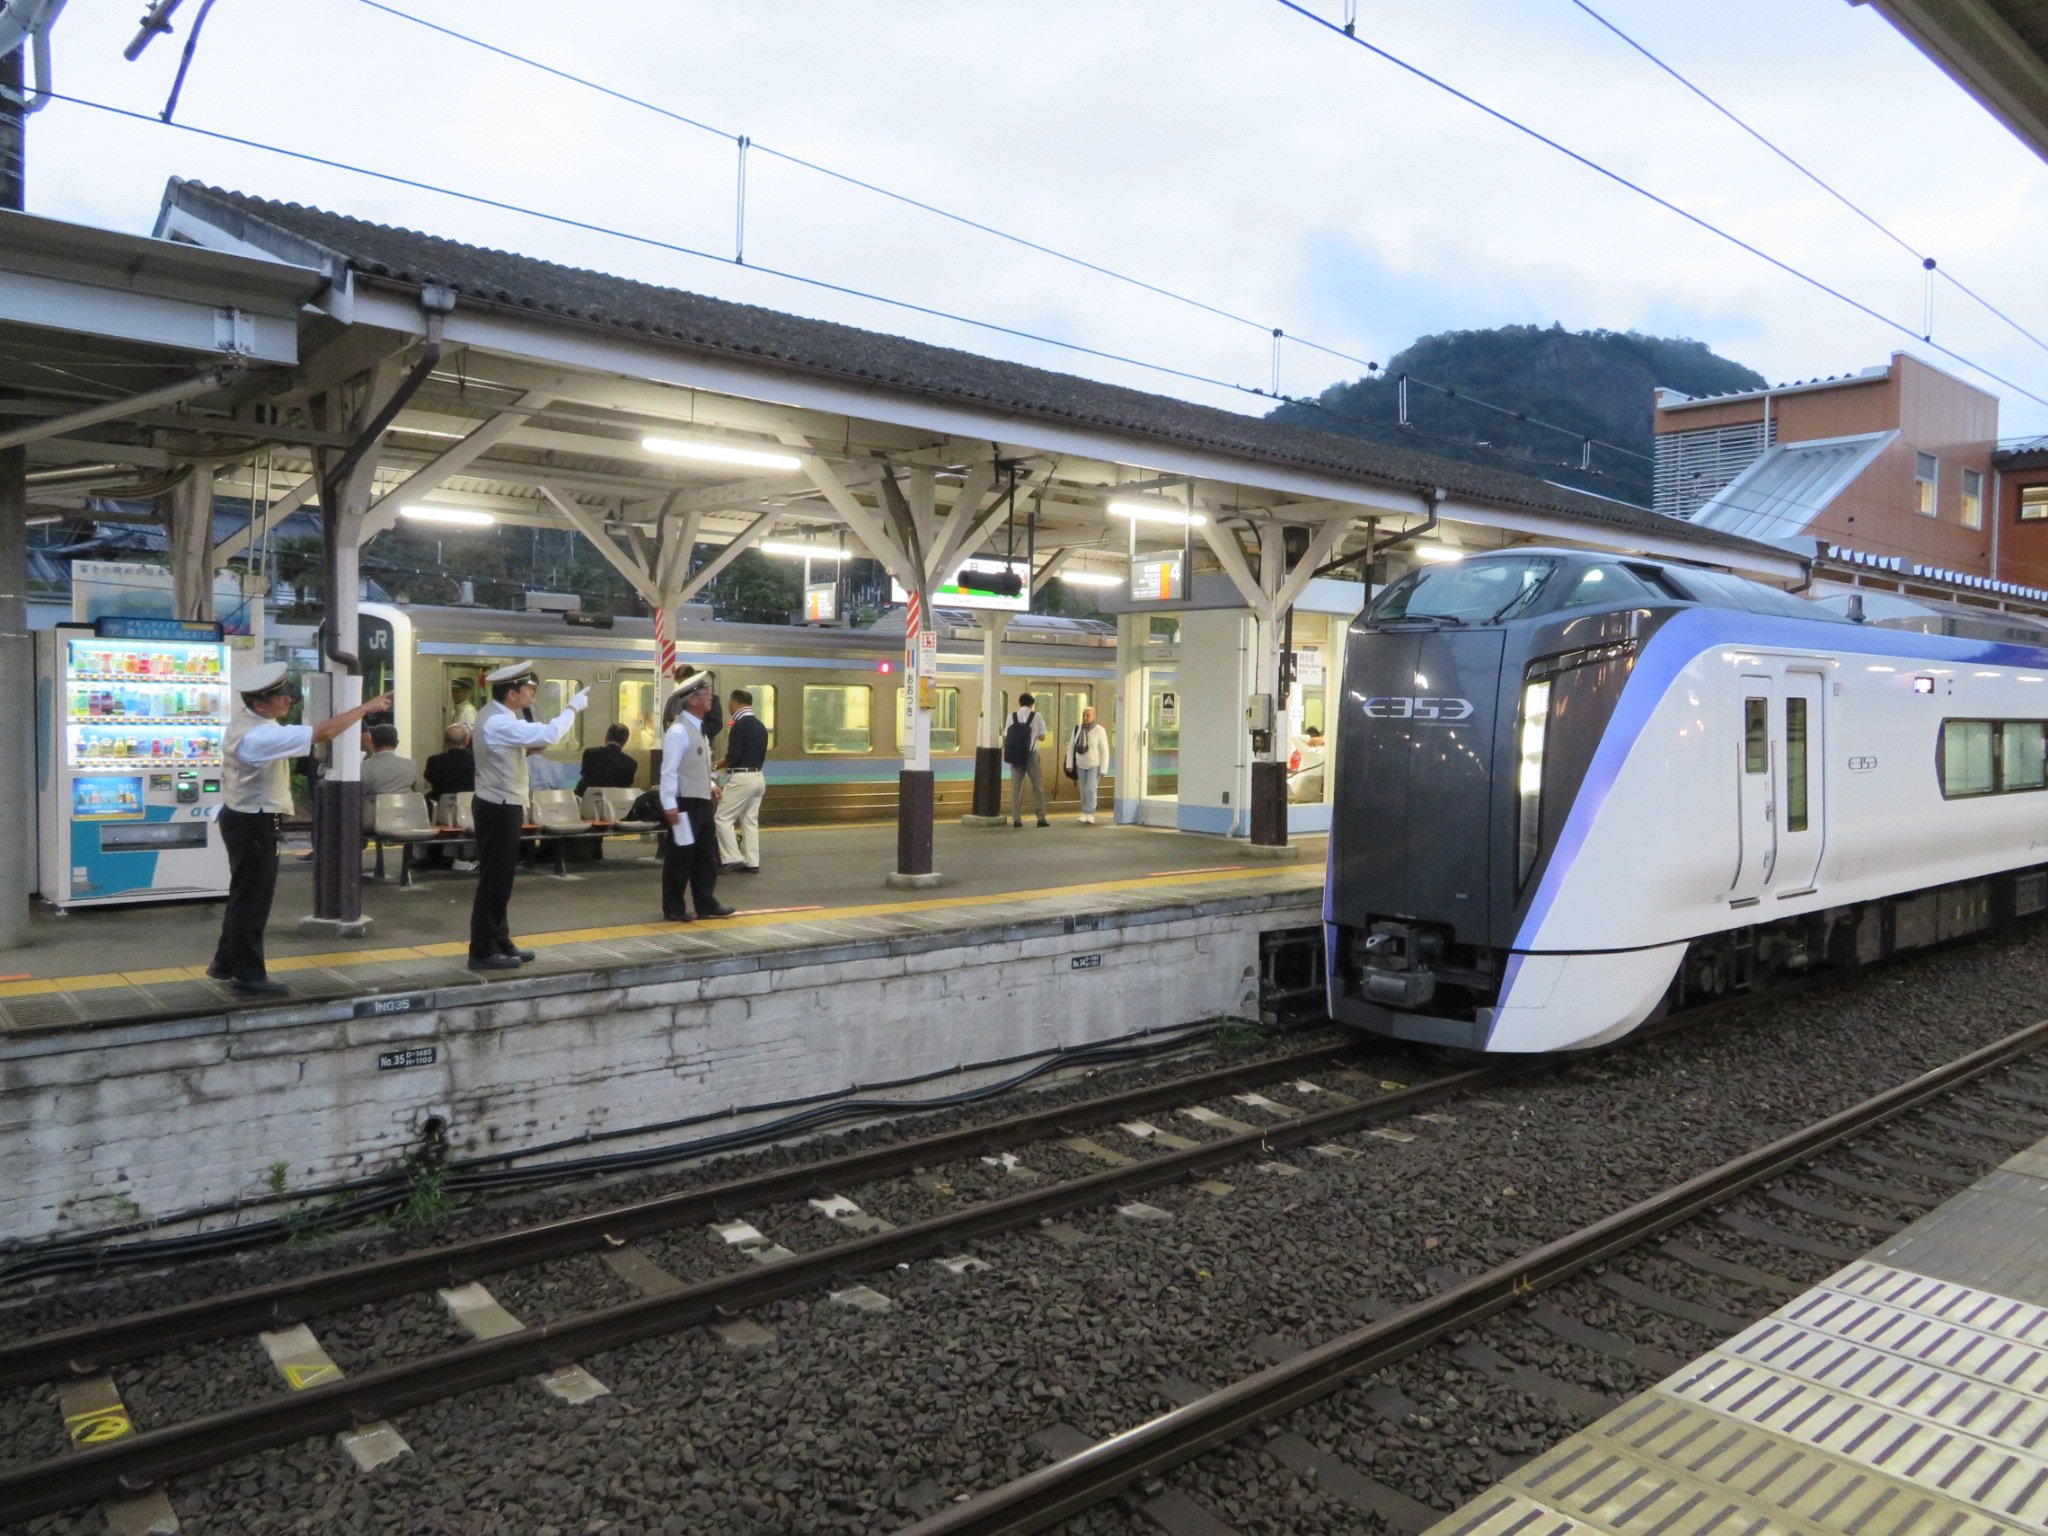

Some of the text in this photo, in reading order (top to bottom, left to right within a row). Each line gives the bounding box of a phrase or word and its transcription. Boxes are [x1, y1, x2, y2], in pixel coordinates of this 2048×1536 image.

[1170, 562, 1180, 581] 4
[369, 630, 386, 649] JR
[906, 675, 914, 716] おおつき
[1363, 697, 1474, 719] E353
